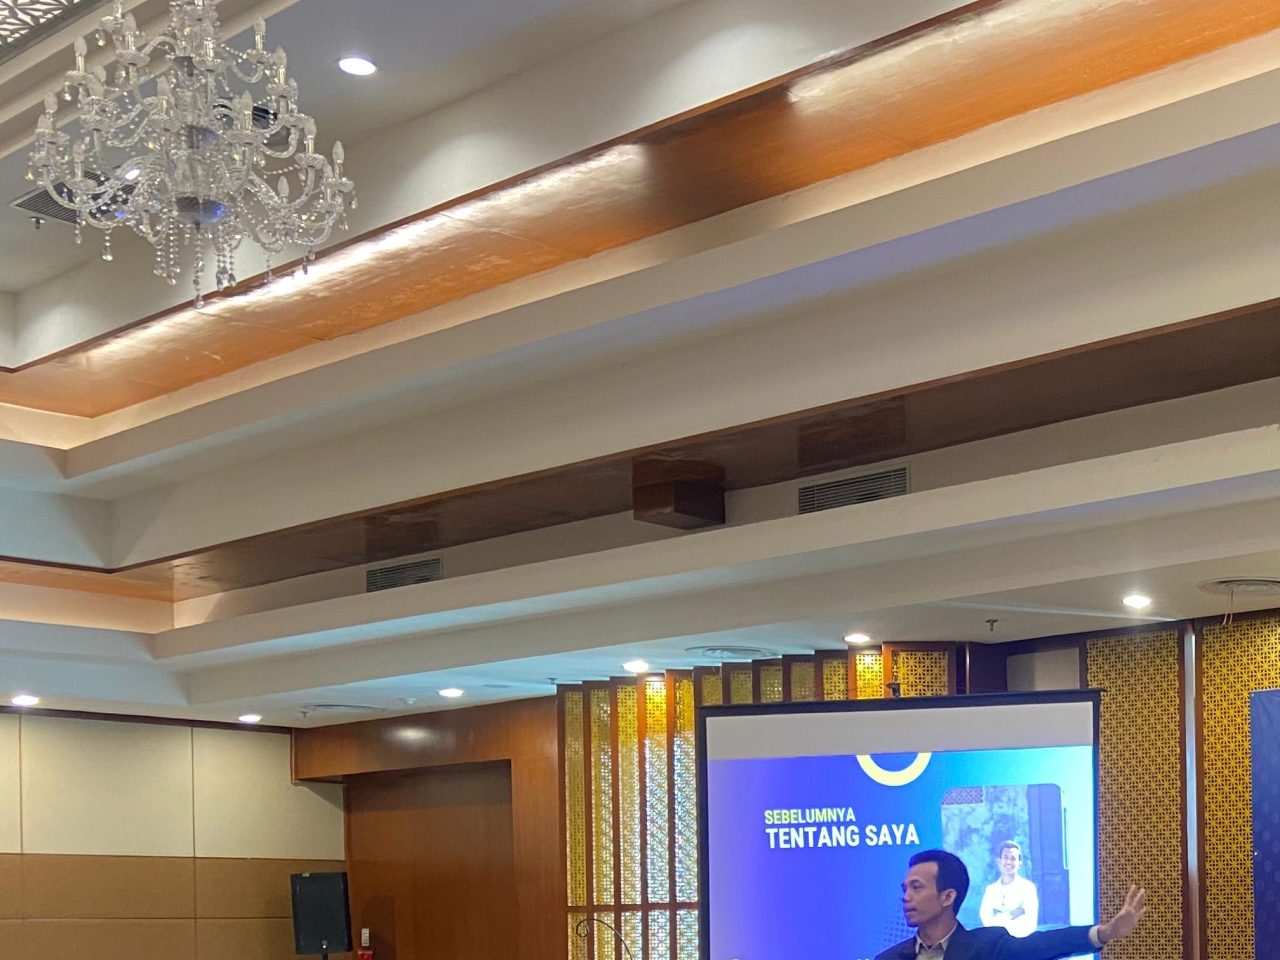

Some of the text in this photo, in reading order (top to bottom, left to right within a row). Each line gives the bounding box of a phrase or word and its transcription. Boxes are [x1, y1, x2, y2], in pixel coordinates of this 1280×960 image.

[764, 807, 856, 825] SEBELUMNYA
[765, 823, 920, 849] TENTANG SAYA
